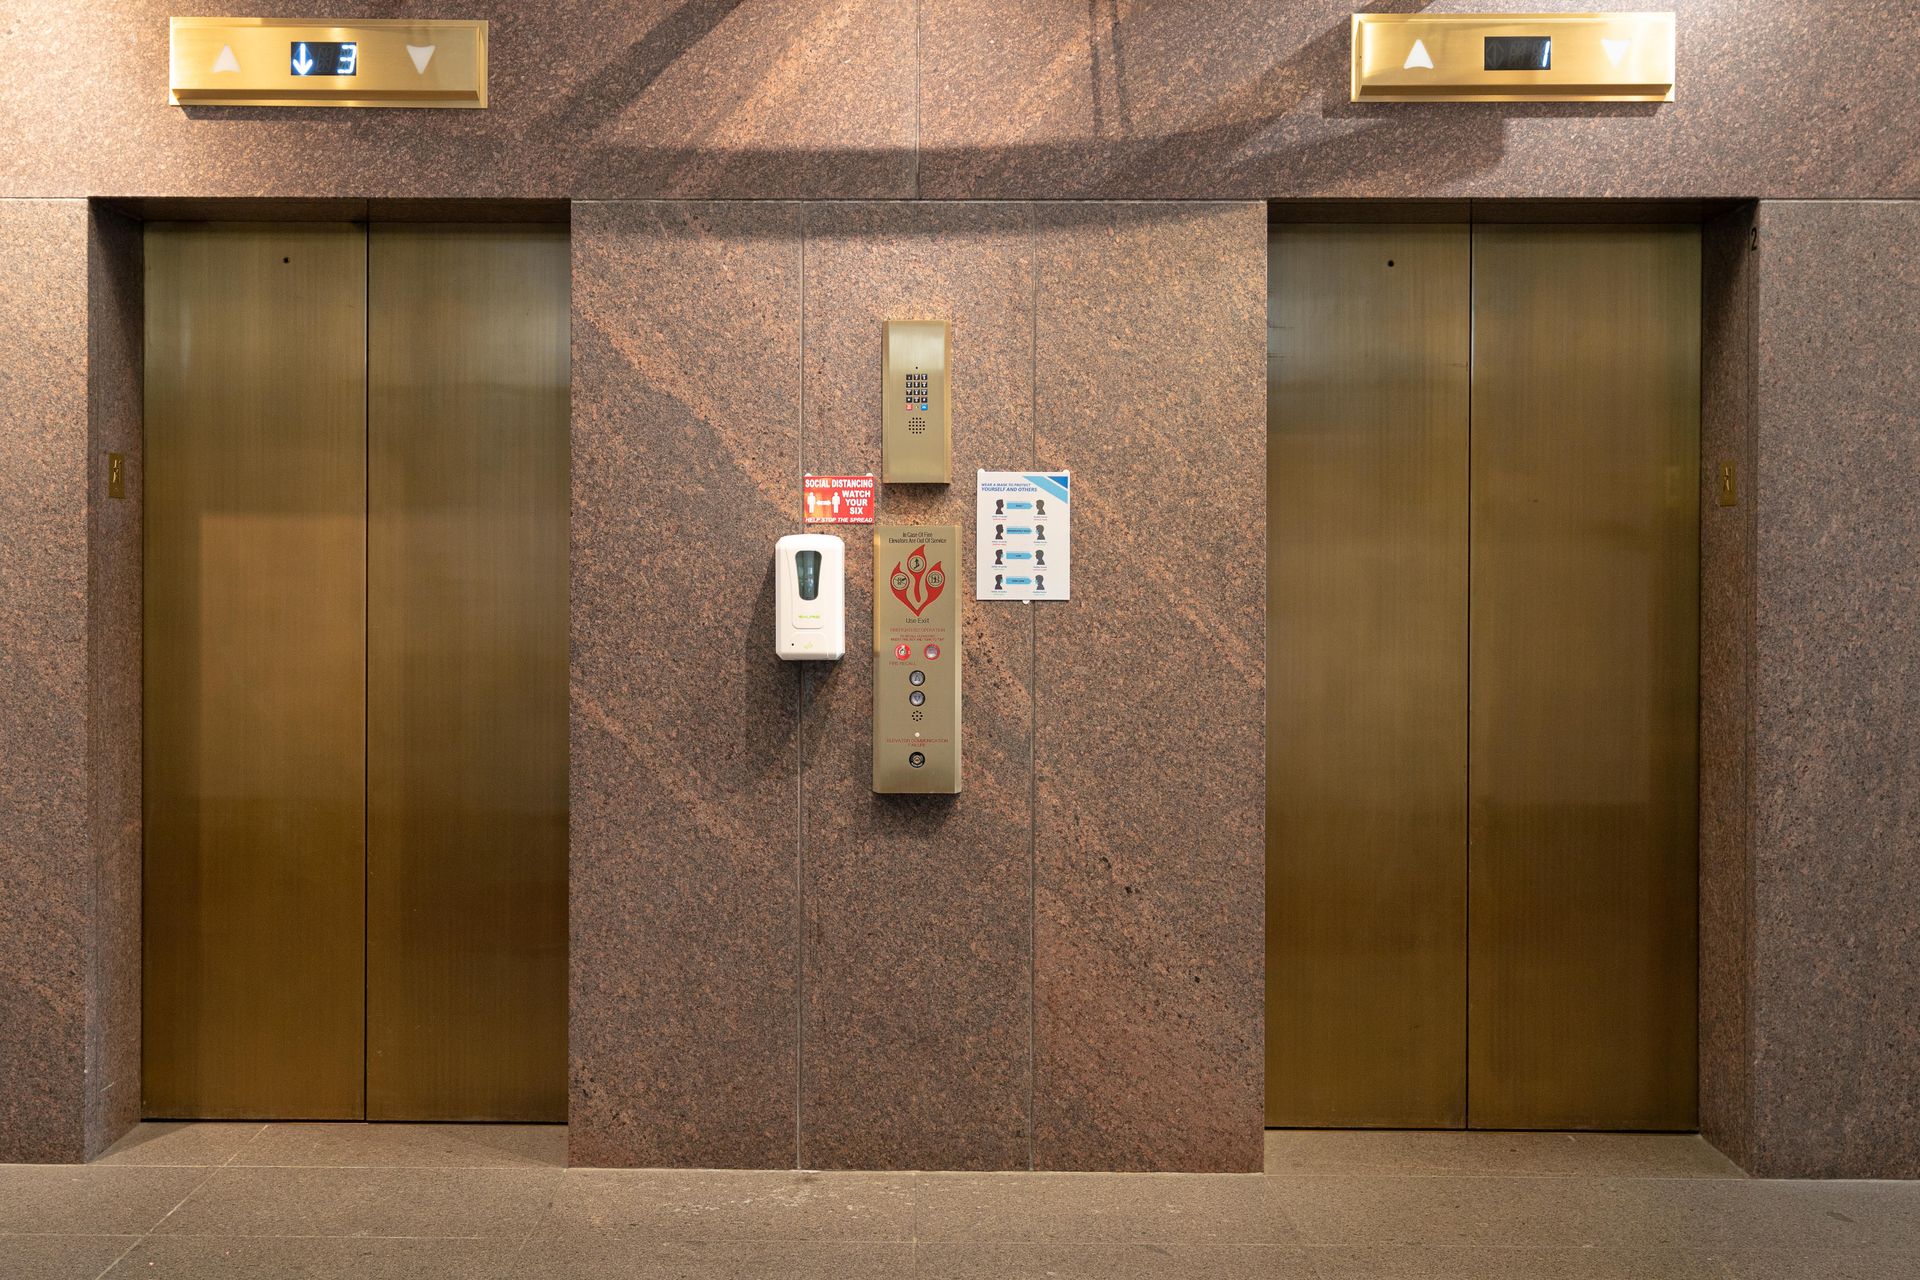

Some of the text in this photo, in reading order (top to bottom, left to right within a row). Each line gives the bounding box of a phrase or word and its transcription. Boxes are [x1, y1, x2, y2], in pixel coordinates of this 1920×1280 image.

[337, 45, 356, 73] 3
[1751, 227, 1757, 251] 2
[805, 479, 873, 488] SOCIAL DISTANCING
[842, 490, 871, 498] WATCH
